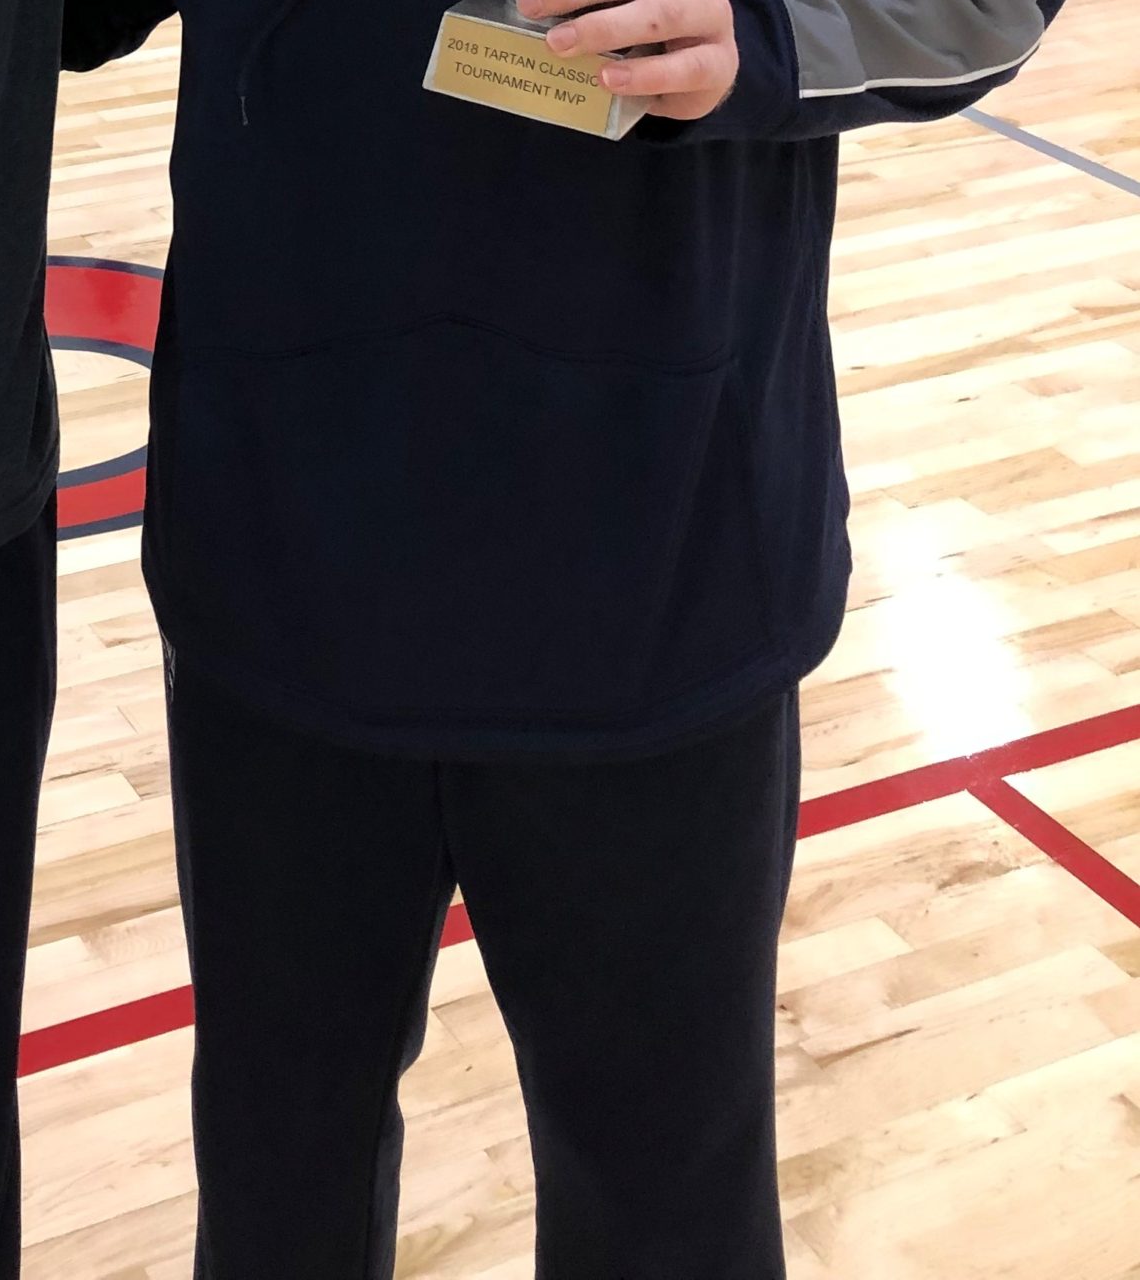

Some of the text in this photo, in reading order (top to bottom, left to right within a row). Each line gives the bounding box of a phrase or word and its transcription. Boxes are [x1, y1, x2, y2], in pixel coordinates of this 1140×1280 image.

[447, 37, 600, 87] 2018 TARTAN CLASSIC
[455, 61, 587, 107] TOURNAMENT MVP
